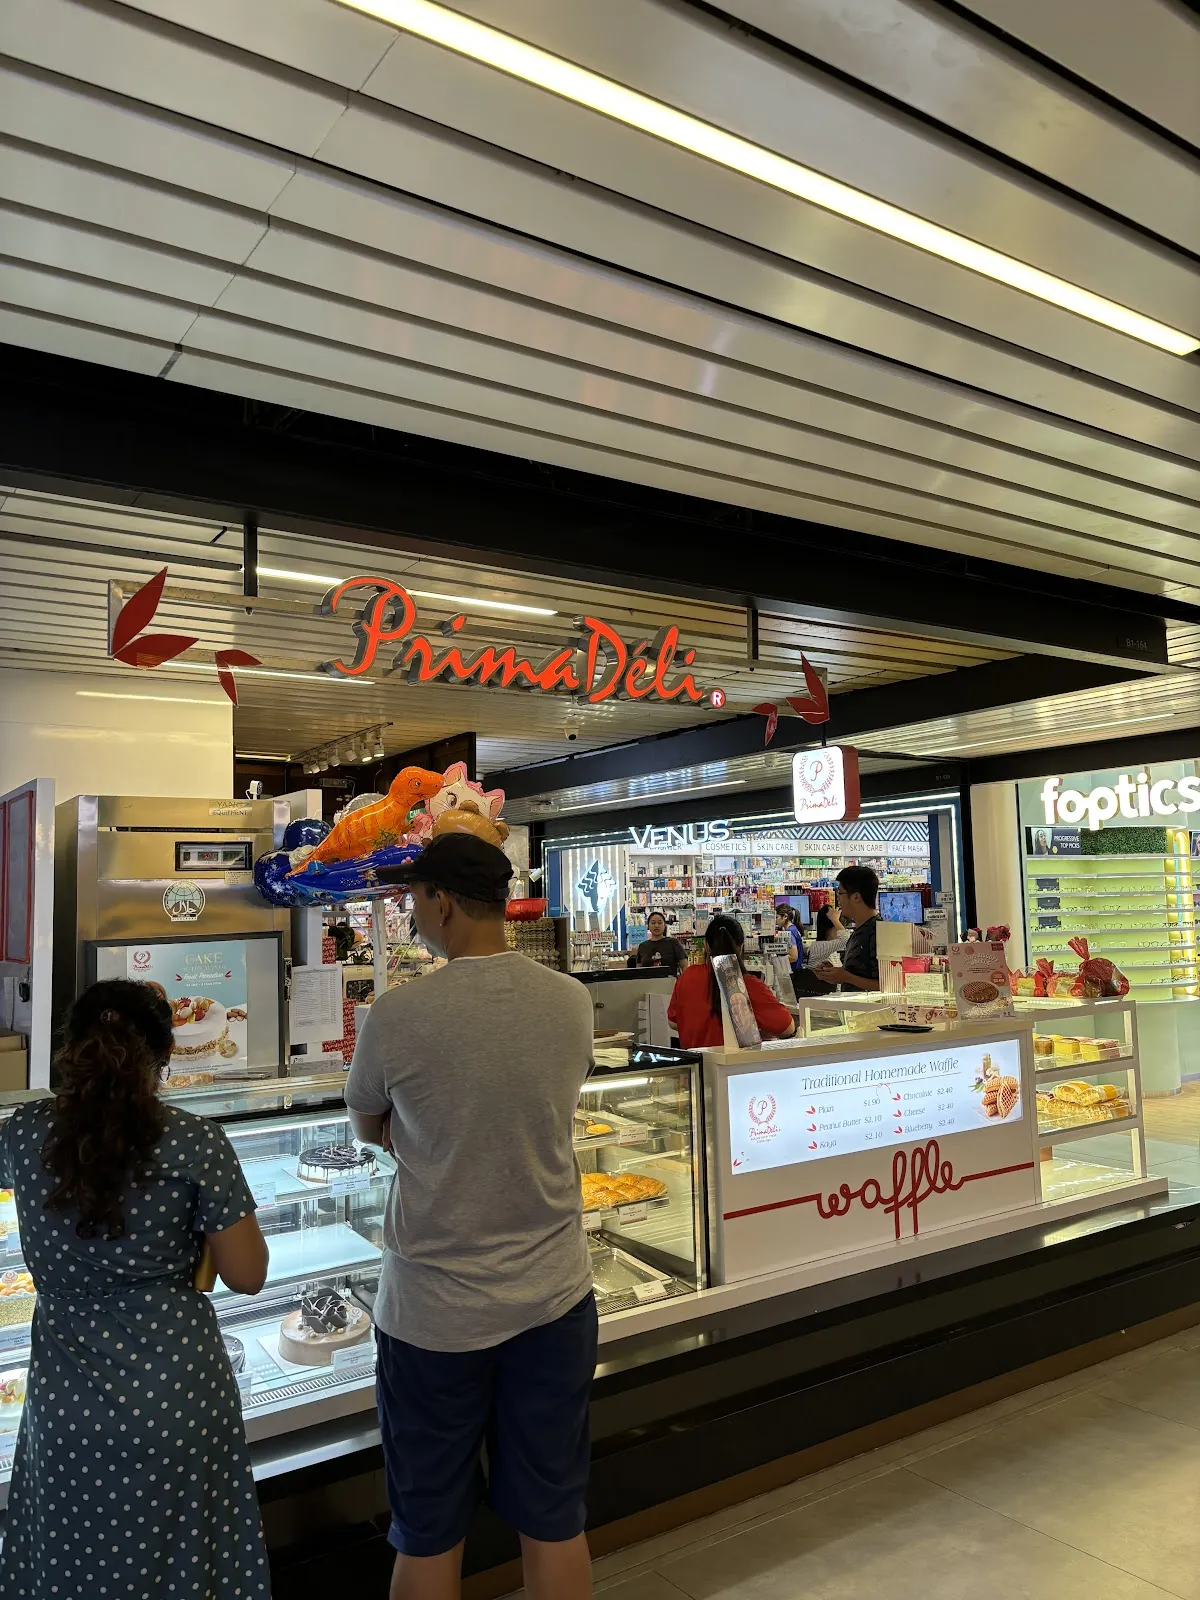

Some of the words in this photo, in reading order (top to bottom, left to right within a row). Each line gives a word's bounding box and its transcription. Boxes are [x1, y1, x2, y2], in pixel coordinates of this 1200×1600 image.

[1040, 772, 1200, 831] foptics
[628, 818, 731, 849] VENUS
[705, 842, 747, 852] COSMETICS
[756, 842, 775, 851] SKIN
[777, 842, 794, 851] CARE
[804, 843, 820, 852] SKIN
[821, 843, 840, 852] CARE
[849, 843, 864, 852] SKIN
[866, 843, 883, 852] CARE
[892, 844, 906, 853] FACE
[907, 844, 924, 853] MASK
[802, 1069, 862, 1090] Traditional
[864, 1062, 927, 1082] Homemade
[930, 1057, 959, 1075] Waffle
[903, 1089, 933, 1101] Chocolate
[937, 1086, 953, 1096] $2.40
[818, 1104, 834, 1115] Plain
[904, 1106, 926, 1117] Cheese
[937, 1102, 954, 1112] $2.40
[819, 1120, 842, 1132] Peanut
[843, 1117, 862, 1128] Butter
[864, 1114, 883, 1124] $2.10
[904, 1122, 933, 1134] Blueberry
[938, 1117, 955, 1128] $2.40
[819, 1139, 838, 1151] Kaya
[865, 1131, 883, 1141] $2.10
[815, 1139, 965, 1239] waffle
